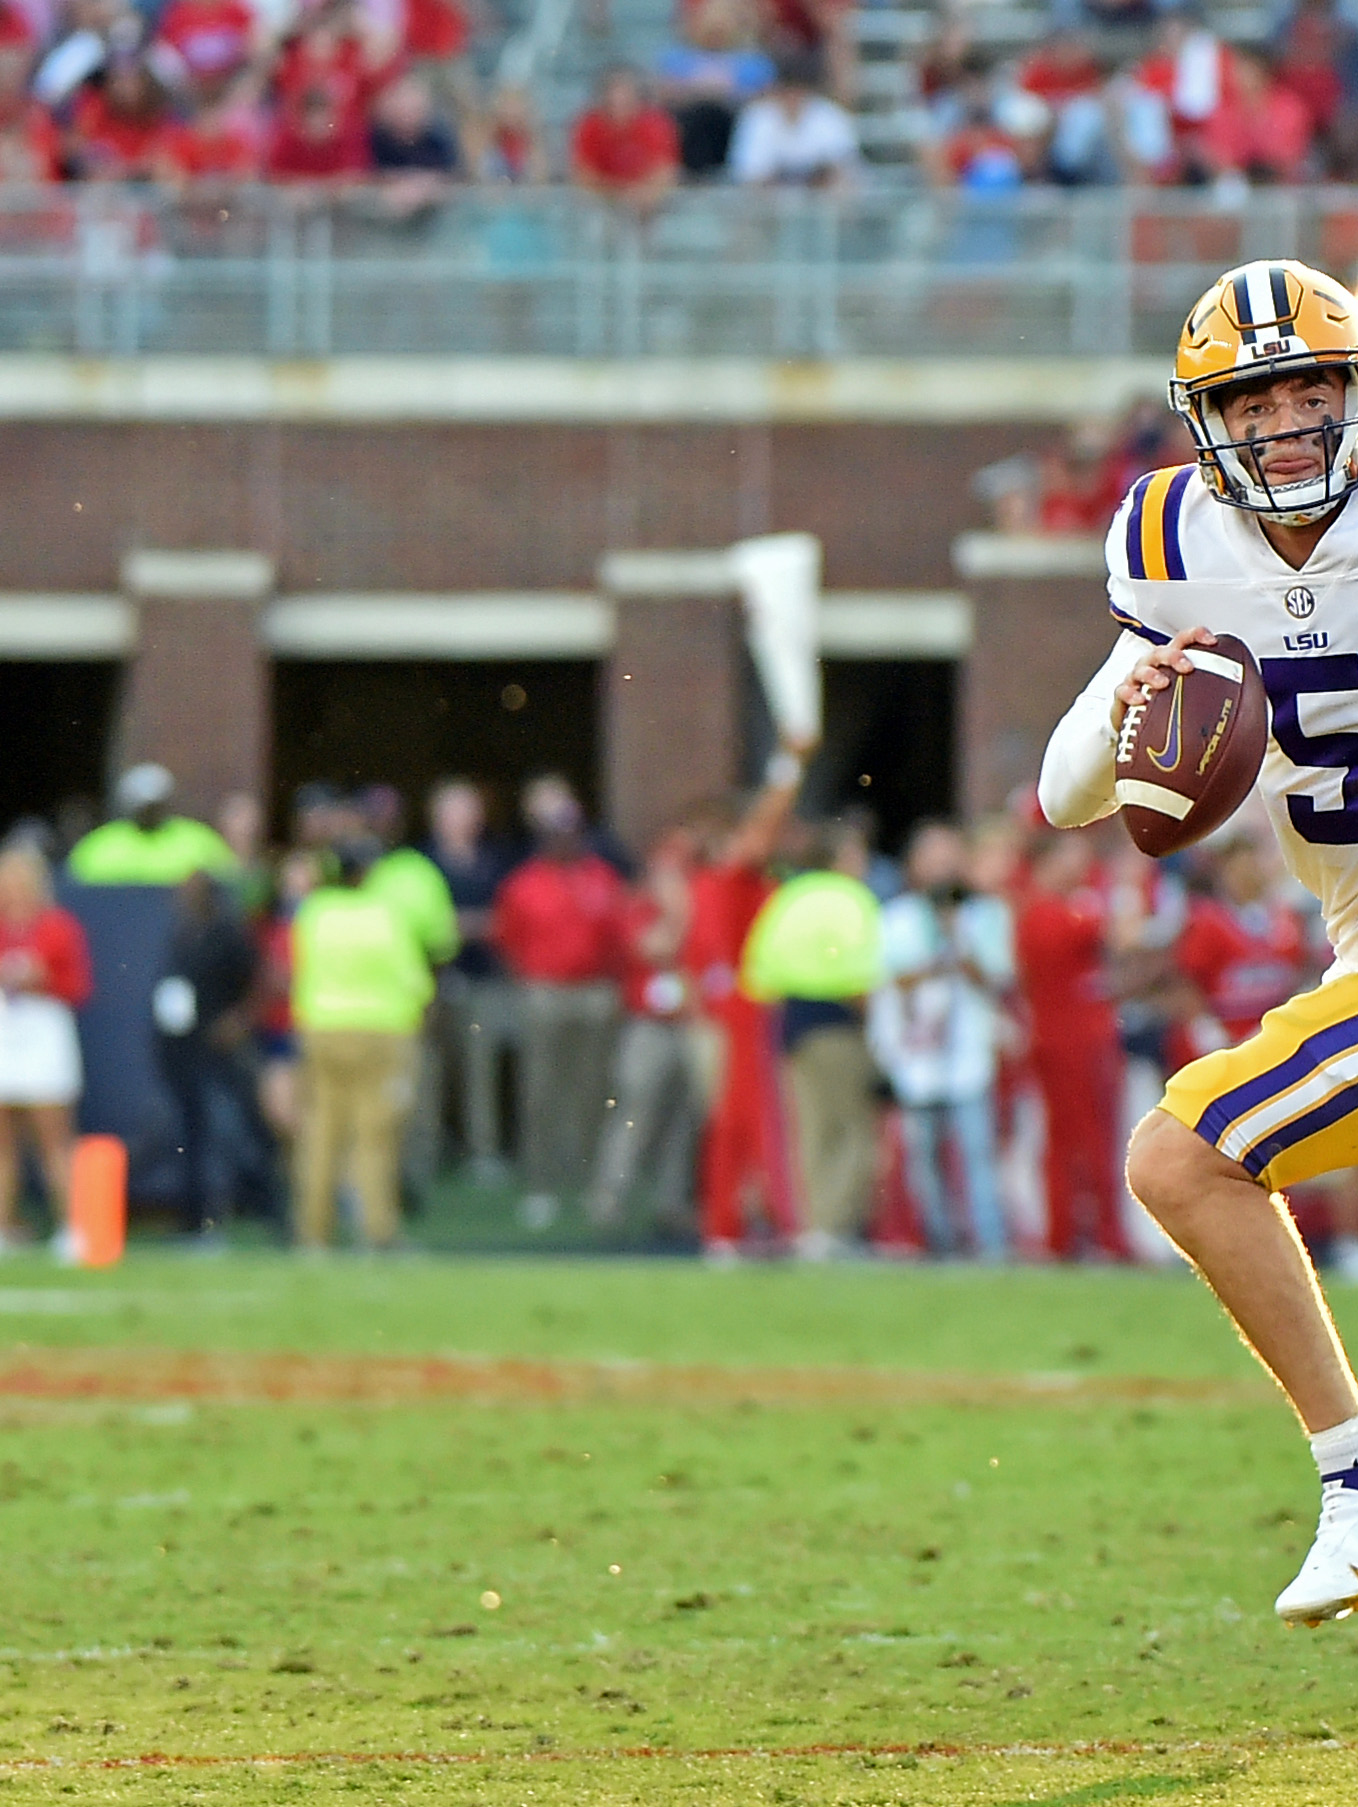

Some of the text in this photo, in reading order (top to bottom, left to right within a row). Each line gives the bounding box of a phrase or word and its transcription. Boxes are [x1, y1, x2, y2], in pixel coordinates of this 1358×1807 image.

[1251, 339, 1291, 360] LSU
[1286, 587, 1314, 617] SEC
[1282, 631, 1329, 652] LSU
